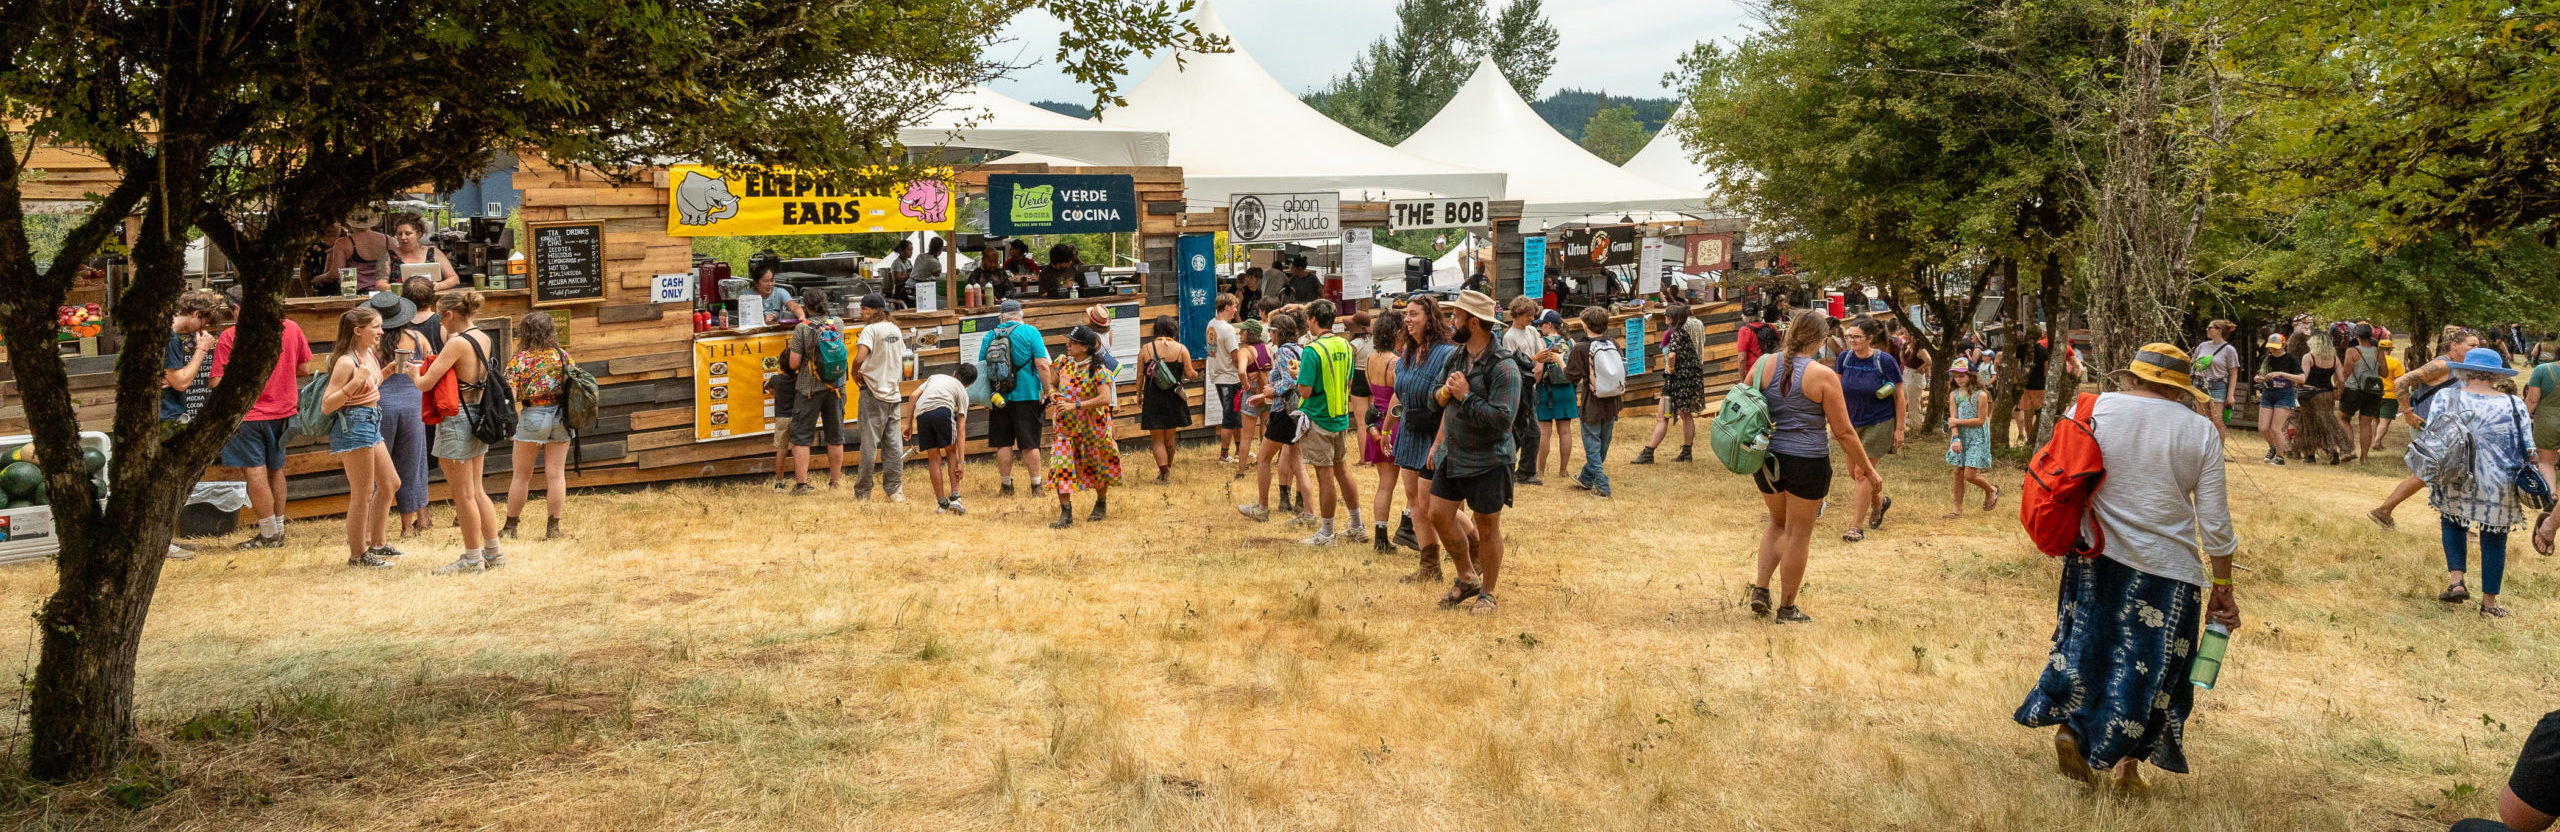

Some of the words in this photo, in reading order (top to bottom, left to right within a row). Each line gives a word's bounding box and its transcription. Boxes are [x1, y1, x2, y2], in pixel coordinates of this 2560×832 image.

[1014, 191, 1049, 209] Verde
[1060, 189, 1107, 202] VERDE
[1283, 194, 1319, 213] obon
[783, 200, 860, 225] EARS
[1061, 208, 1121, 221] COCINA
[1395, 203, 1435, 226] THE
[1445, 201, 1484, 224] BOB
[565, 228, 590, 236] DRINKS
[1567, 242, 1588, 256] Urban
[1611, 241, 1633, 253] German
[661, 277, 684, 288] CASH
[661, 288, 683, 299] ONLY
[706, 341, 762, 359] THAI
